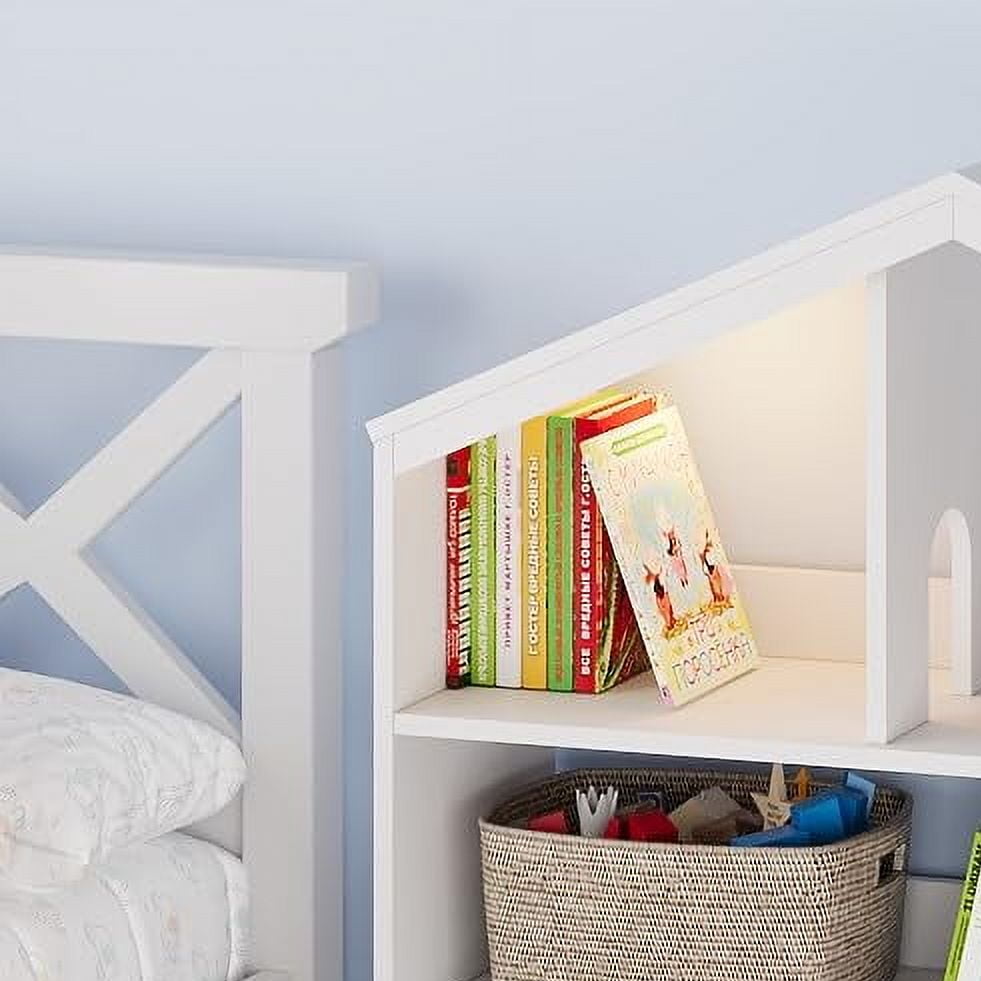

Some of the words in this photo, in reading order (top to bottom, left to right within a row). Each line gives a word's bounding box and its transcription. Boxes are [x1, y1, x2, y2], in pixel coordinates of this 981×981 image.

[581, 509, 591, 568] СОВЕТЫ
[581, 571, 592, 640] ВРЕДНЫЕ
[581, 648, 591, 674] ВСЕ
